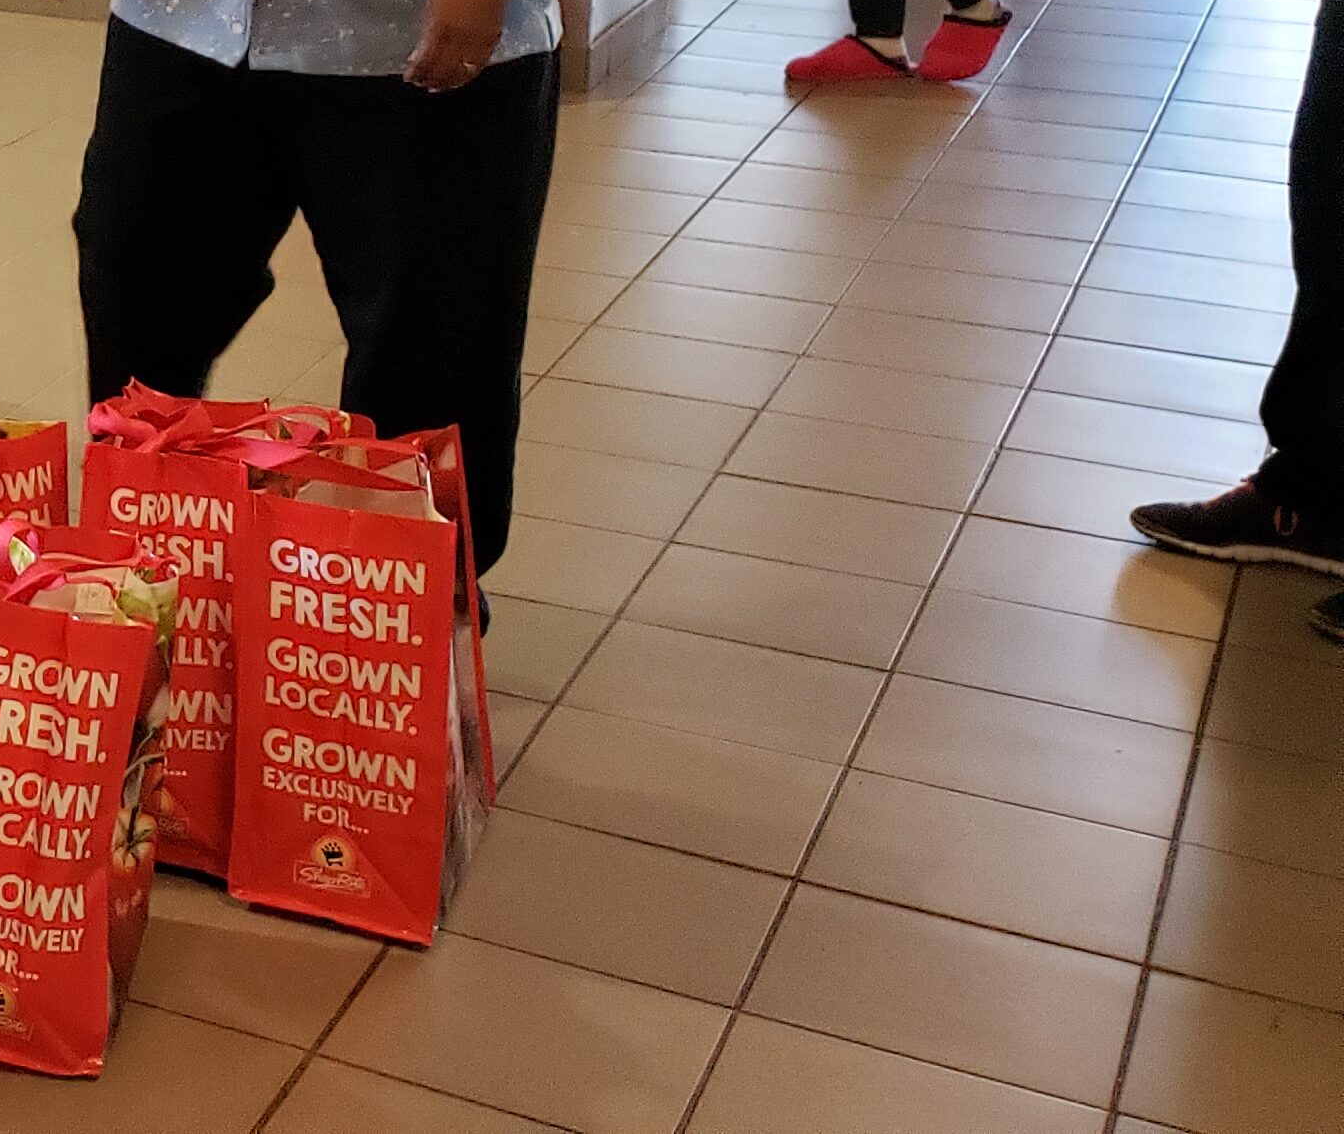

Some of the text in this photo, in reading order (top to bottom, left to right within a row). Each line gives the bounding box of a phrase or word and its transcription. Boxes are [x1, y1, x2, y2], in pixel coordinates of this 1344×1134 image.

[111, 487, 234, 535] GROWN
[269, 539, 426, 595] GROWN
[269, 580, 423, 647] FRESH.
[267, 637, 422, 700] GROWN
[265, 675, 418, 736] LOCALLY.
[262, 728, 417, 791] GROWN
[263, 766, 414, 816] EXCLUSIVELY
[303, 802, 370, 834] FOR...
